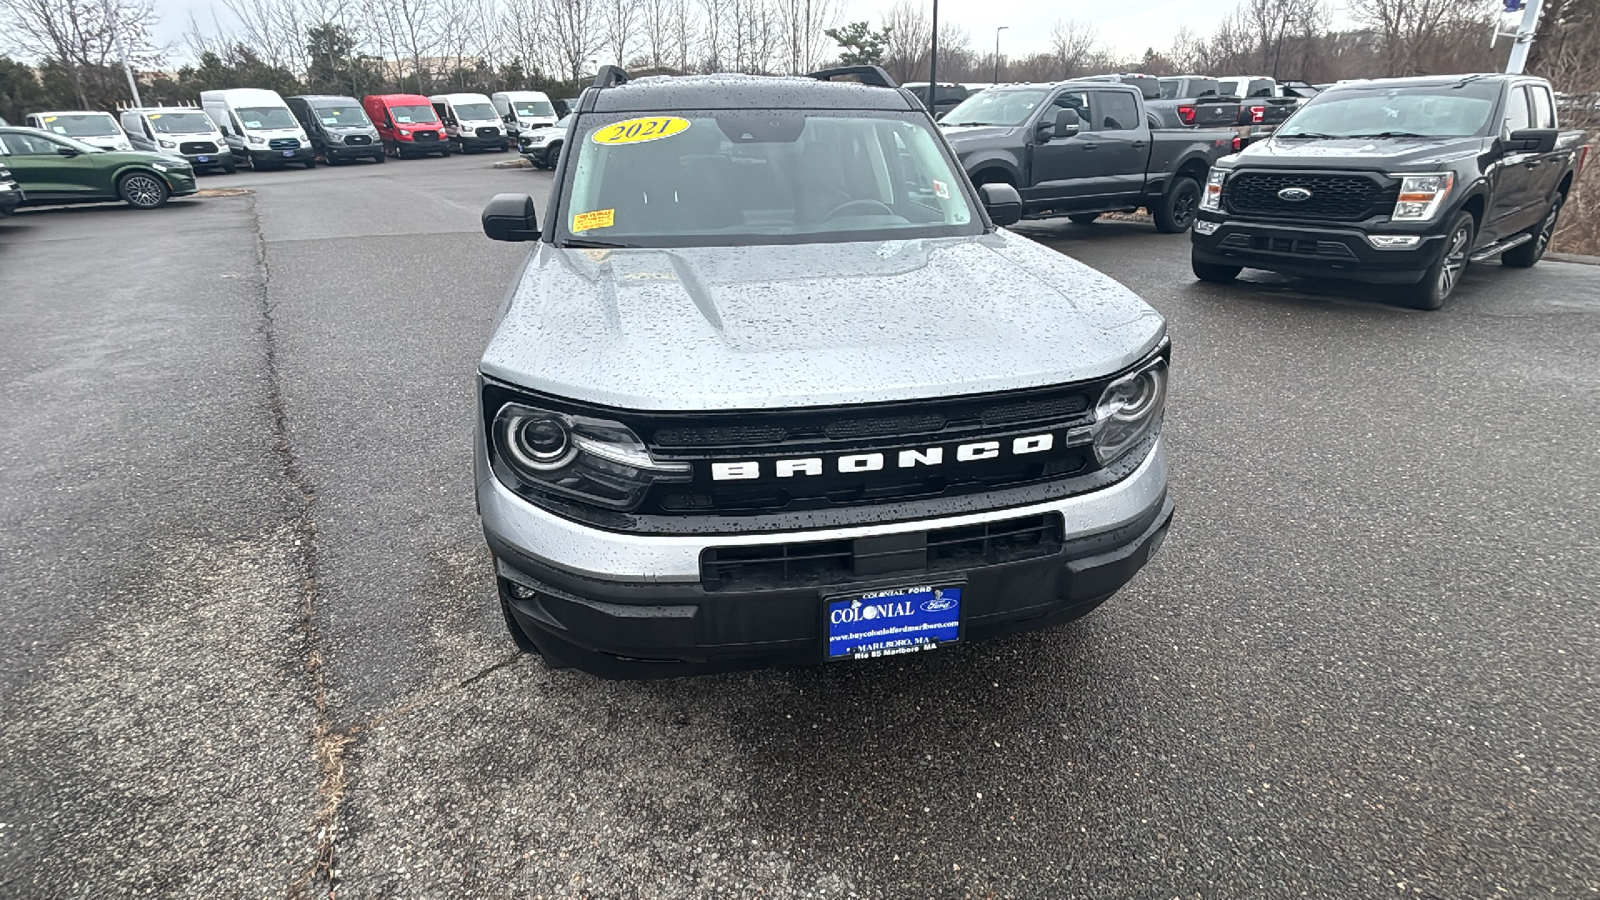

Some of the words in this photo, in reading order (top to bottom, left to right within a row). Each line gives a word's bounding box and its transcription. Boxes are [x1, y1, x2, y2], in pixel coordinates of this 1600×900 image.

[608, 119, 671, 141] 2021
[711, 433, 1053, 481] BRONCO
[863, 589, 905, 600] COLONIAL
[908, 586, 932, 595] FORD
[830, 601, 915, 624] COLONIAL
[829, 620, 959, 643] www.buycolonialfordmarlboro.com
[854, 652, 869, 660] Rte
[883, 646, 920, 656] Marlboro
[923, 643, 938, 651] MA
[857, 639, 912, 653] MARLBORO,
[914, 636, 930, 645] MA
